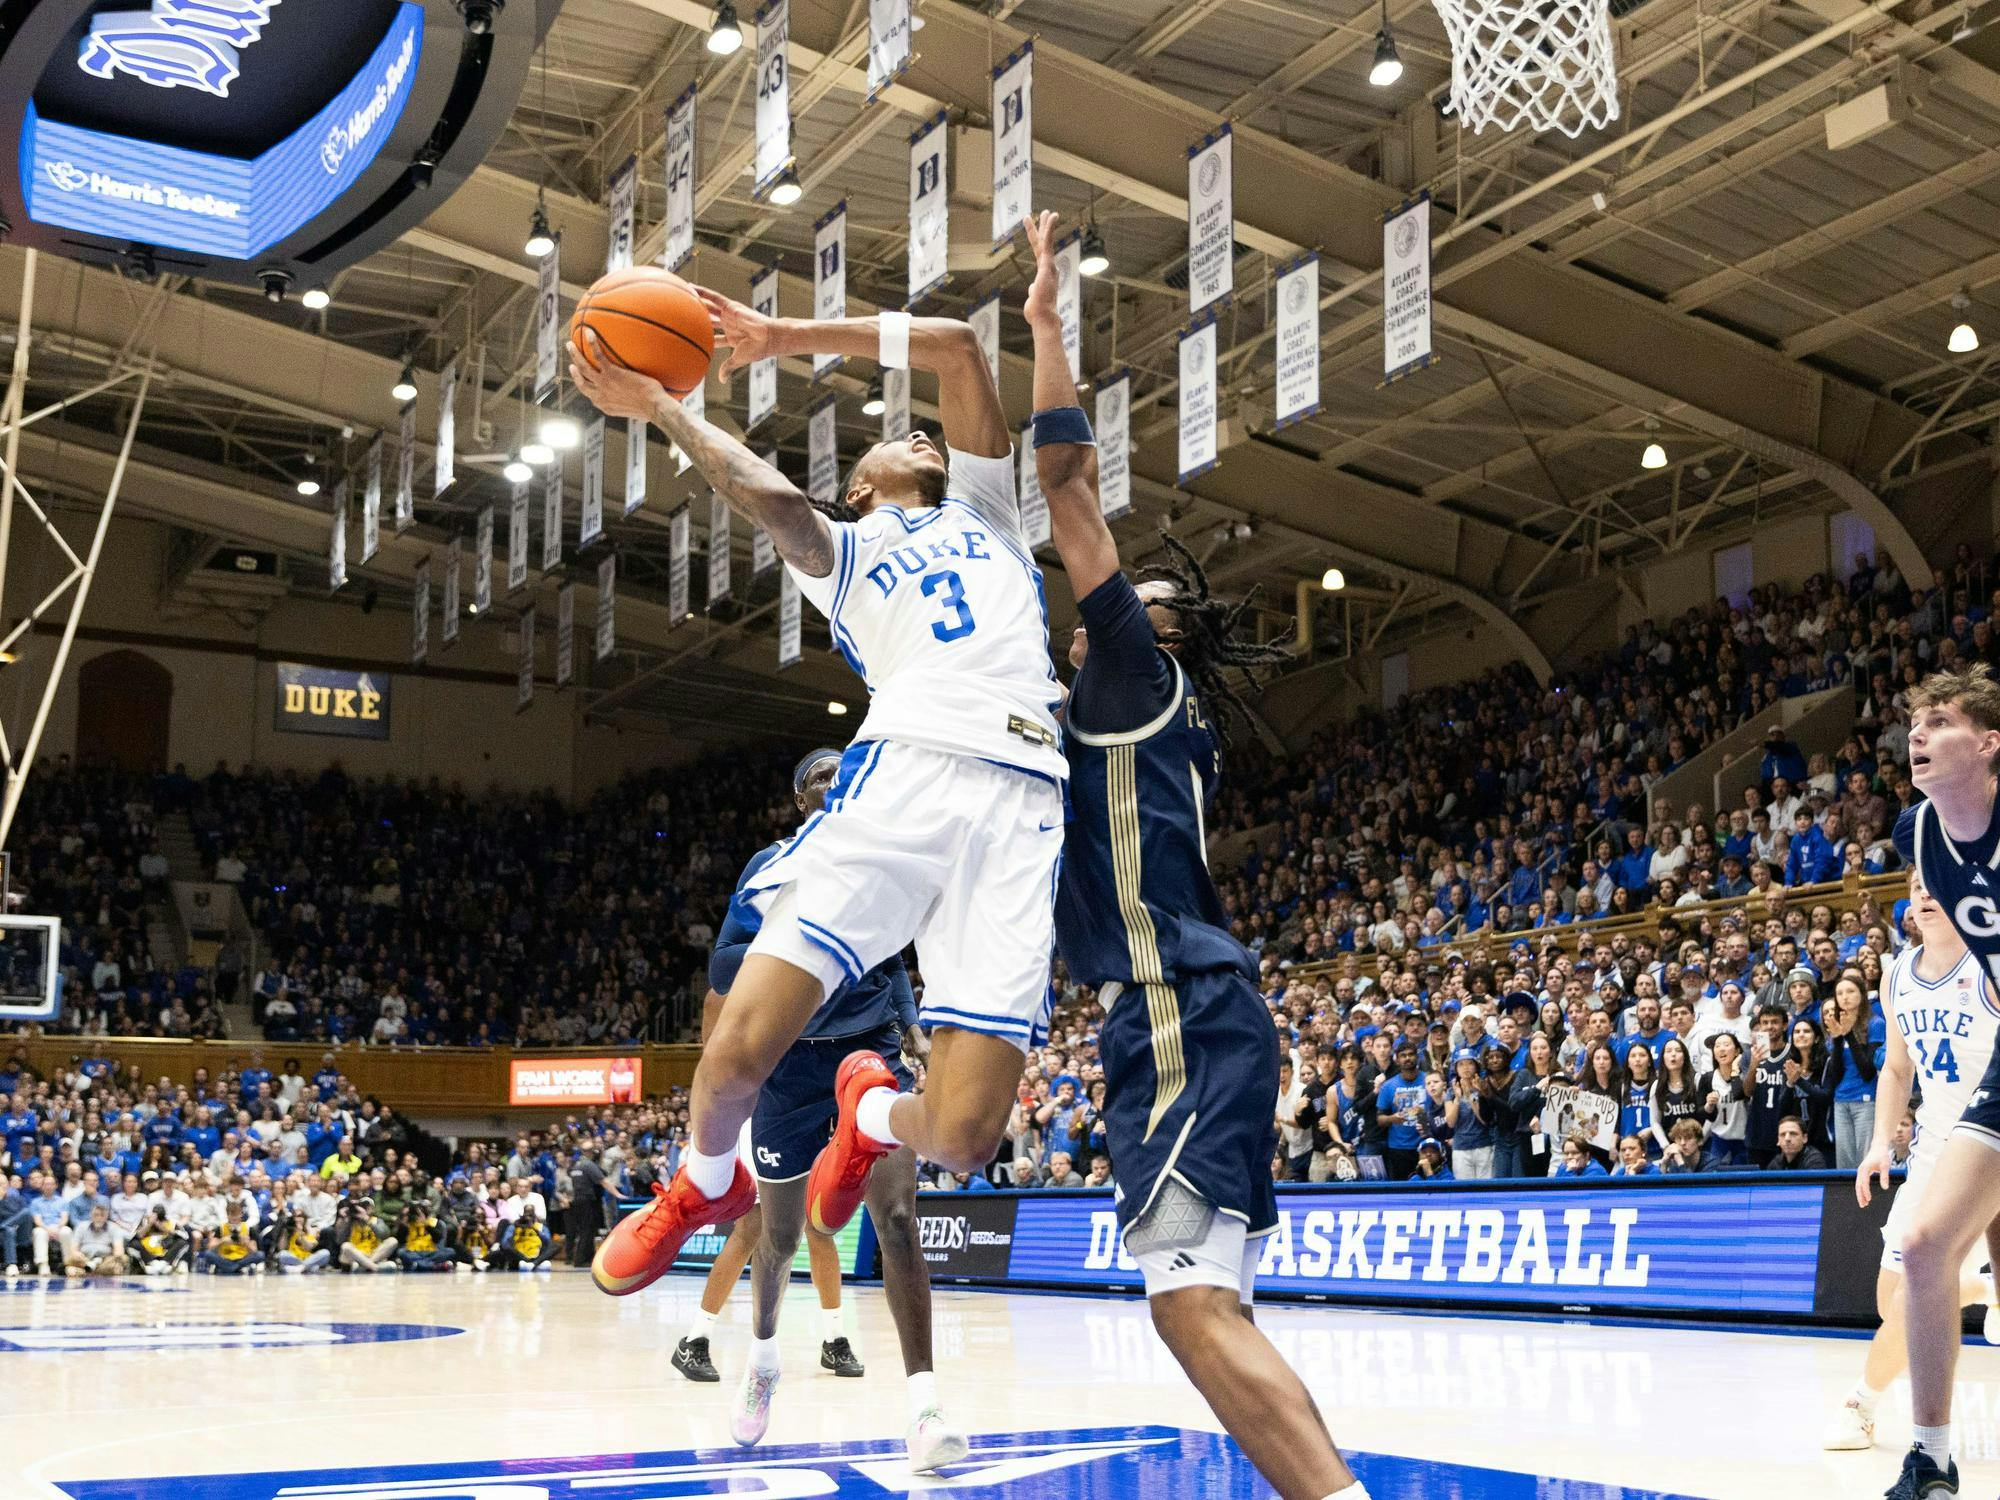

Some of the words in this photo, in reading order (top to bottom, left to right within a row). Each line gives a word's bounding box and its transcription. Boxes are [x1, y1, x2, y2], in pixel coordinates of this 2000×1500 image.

[78, 0, 281, 97] Du
[759, 54, 784, 101] 43
[348, 85, 387, 150] Harris
[669, 151, 690, 193] 44
[90, 172, 163, 205] Harris
[163, 186, 241, 218] Teeter
[1196, 200, 1223, 226] ATLANTIC
[1200, 217, 1220, 239] COAST
[1189, 225, 1230, 258] CONFERENCE
[1191, 241, 1228, 272] CHAMPIONS
[1391, 264, 1421, 288] ATLANTIC
[1385, 288, 1428, 320] CONFERENCE
[1396, 281, 1417, 301] COAST
[1283, 320, 1311, 342] ATLANTIC
[1386, 305, 1426, 333] CHAMPIONS
[1286, 335, 1306, 352] COAST
[1397, 340, 1416, 359] 2005
[1278, 345, 1316, 371] CONFERENCE
[1279, 359, 1315, 383] CHAMPIONS
[1289, 391, 1305, 407] 2004
[866, 531, 991, 599] DUKE
[920, 570, 976, 642] 3
[284, 683, 381, 720] DUKE
[1186, 696, 1206, 729] FL
[1897, 1008, 1974, 1038] DUKE
[1916, 1038, 1961, 1084] 14
[517, 1071, 550, 1086] FAN
[551, 1070, 604, 1086] WORK
[1755, 1067, 1783, 1085] Duk
[1545, 1086, 1578, 1112] RING
[1595, 1097, 1616, 1125] DUB
[1626, 1095, 1650, 1108] UK
[1663, 1101, 1696, 1117] Duke
[1766, 1087, 1774, 1108] 1
[1343, 1107, 1358, 1125] DU
[1434, 1116, 1447, 1127] Du
[1635, 1108, 1643, 1128] 1
[757, 1146, 781, 1167] GT
[916, 1216, 966, 1249] EEDS
[969, 1231, 1011, 1245] REEDS.com
[922, 1252, 949, 1262] ELERS
[1255, 1208, 1650, 1287] ASKETBALL
